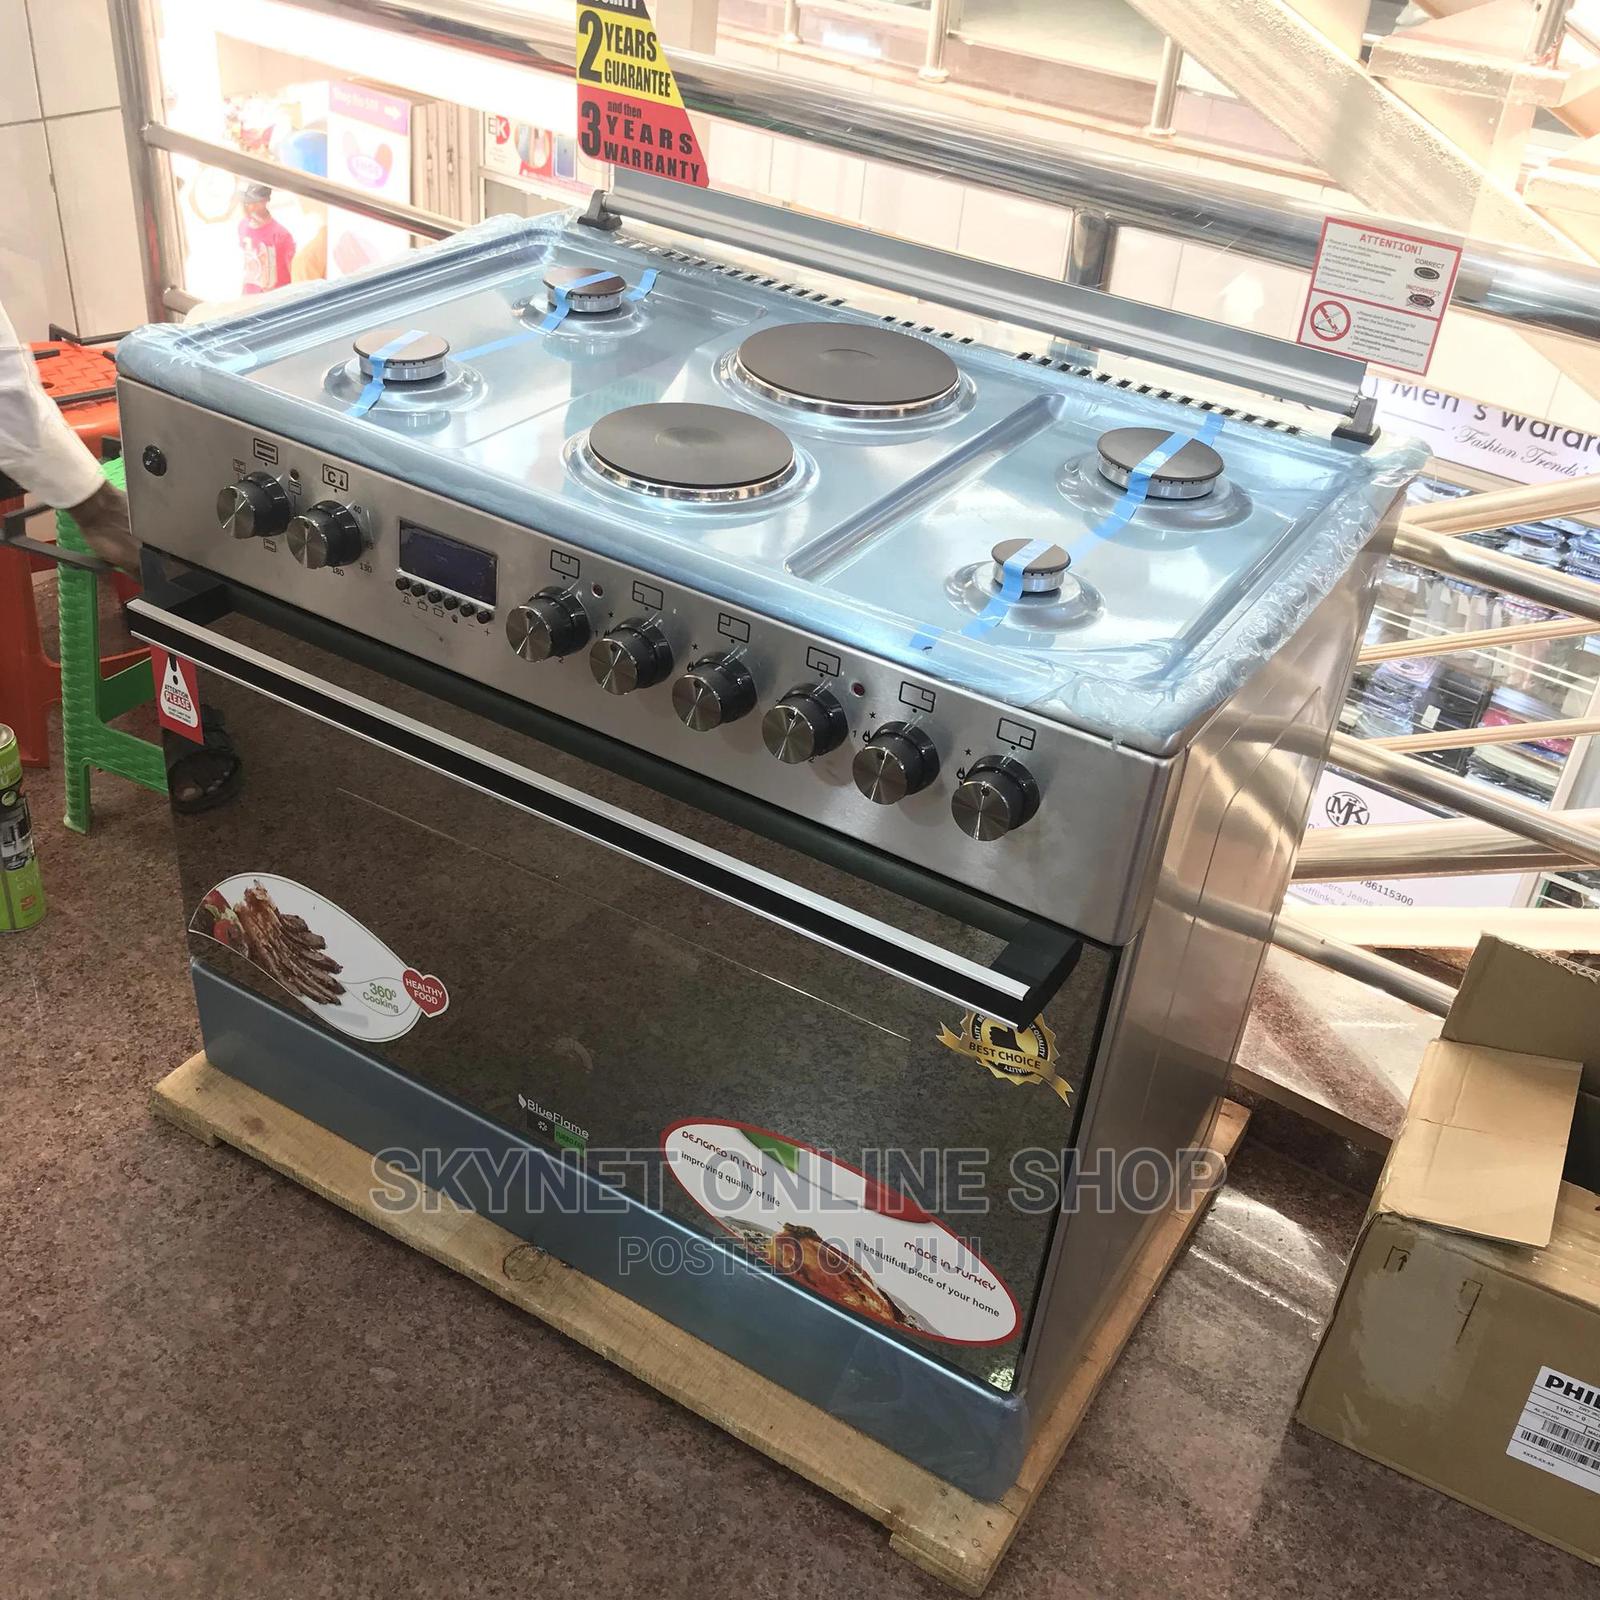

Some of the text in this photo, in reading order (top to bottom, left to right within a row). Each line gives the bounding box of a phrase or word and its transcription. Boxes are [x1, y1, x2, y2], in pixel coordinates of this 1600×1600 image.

[578, 10, 657, 83] 2 YEARS
[604, 58, 671, 97] GUARANTEE
[607, 101, 642, 119] and then
[581, 101, 693, 157] 3 YEARS
[604, 141, 700, 182] WARRANTY
[1359, 233, 1423, 256] ATTENTION!
[1414, 257, 1446, 269] CORRECT
[359, 562, 373, 573] 130
[165, 691, 191, 711] PLEASE
[405, 978, 443, 998] HEALTHY
[413, 990, 438, 1005] FOOD
[362, 991, 399, 1013] Cooking
[969, 1041, 1041, 1069] BEST CHOICE
[527, 1098, 589, 1140] BlueFlame
[681, 1151, 781, 1207] improving quality of life
[855, 1239, 1000, 1317] a beautifull piece of your home
